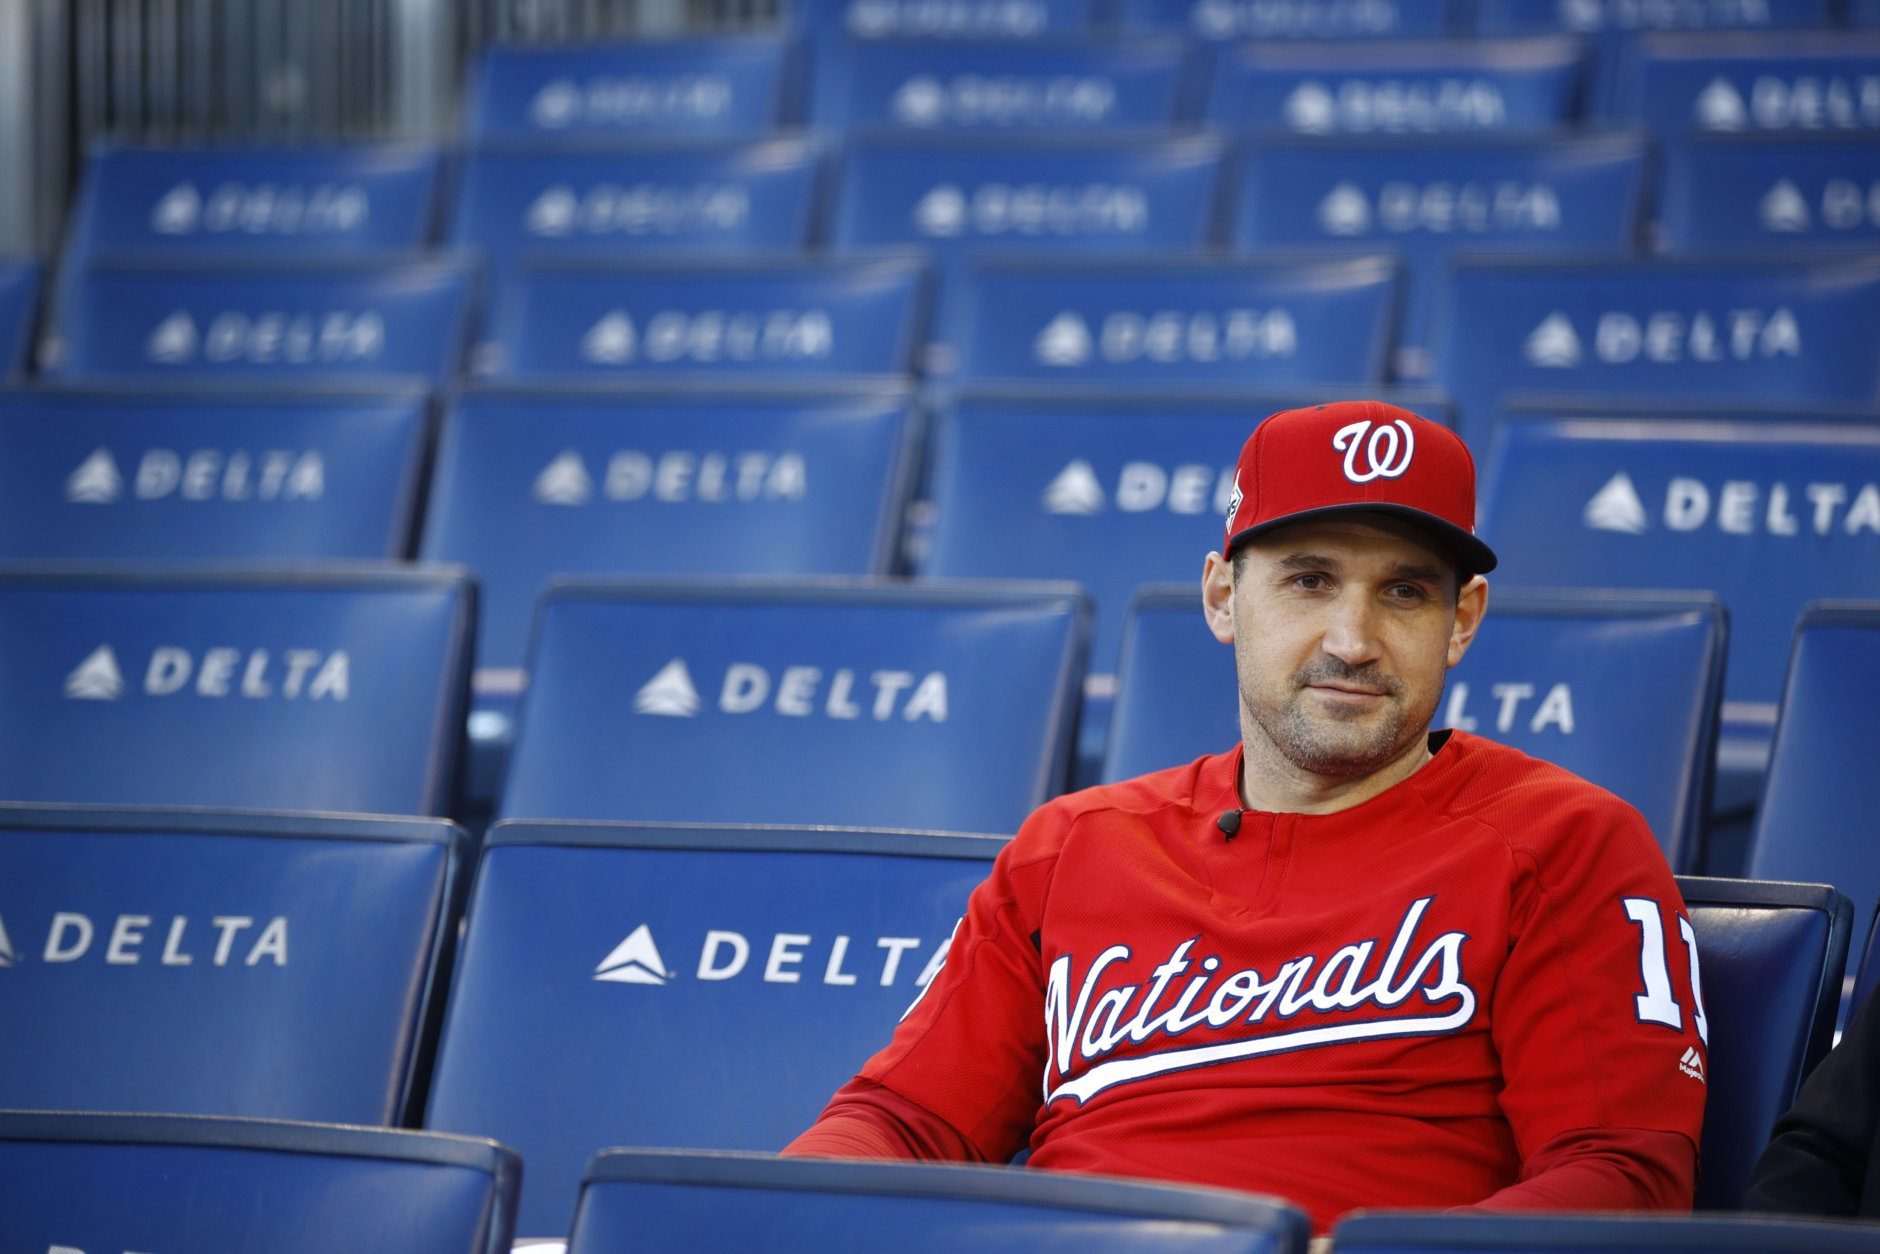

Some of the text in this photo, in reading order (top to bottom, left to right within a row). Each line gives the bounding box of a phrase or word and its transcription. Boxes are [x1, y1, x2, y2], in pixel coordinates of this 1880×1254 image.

[1595, 309, 1799, 361] DELTA
[135, 449, 325, 500] DELTA
[605, 450, 806, 502] DELTA
[1333, 418, 1415, 485] W
[1664, 477, 1880, 535] DELTA
[144, 646, 349, 699] DELTA
[718, 663, 949, 722] DELTA
[1444, 682, 1575, 734] LTA
[43, 912, 289, 966] DELTA
[1043, 895, 1474, 1098] Nationals
[1621, 896, 1708, 1048] 11
